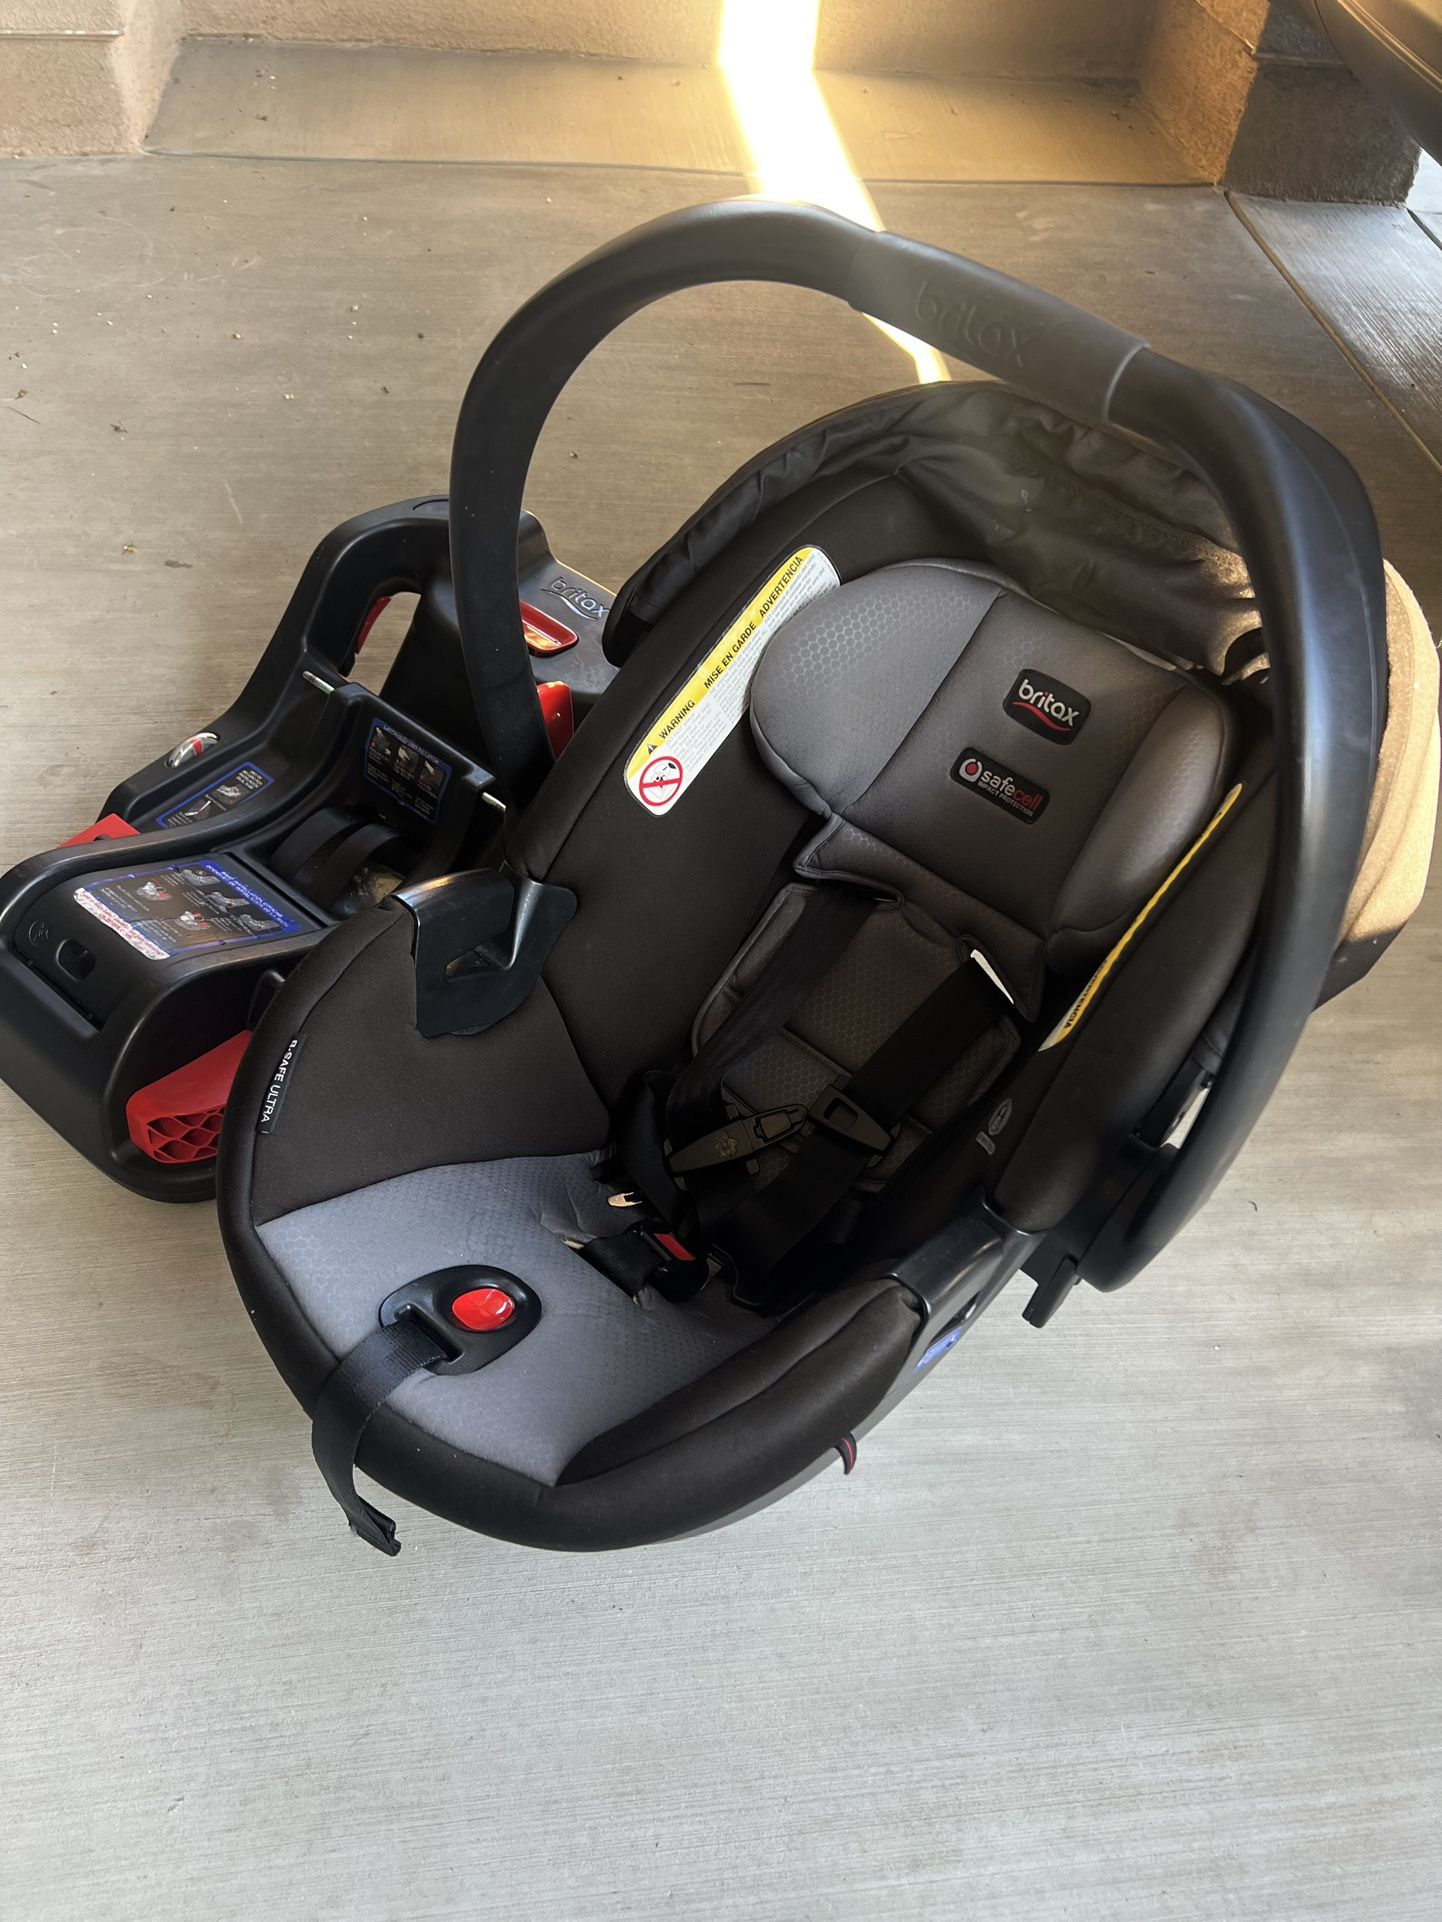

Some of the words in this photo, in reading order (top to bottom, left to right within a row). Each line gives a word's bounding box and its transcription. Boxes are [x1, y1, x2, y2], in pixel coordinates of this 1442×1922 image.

[915, 279, 1031, 368] britax
[551, 576, 610, 618] britax
[658, 699, 696, 740] WARNING
[703, 665, 724, 689] MISE
[722, 651, 735, 668] EN
[731, 621, 758, 654] GARDE
[758, 555, 803, 618] ADVERTENCIA
[1018, 678, 1080, 727] britax
[977, 780, 1001, 797] IMPACT
[999, 792, 1034, 817] PROTECTION
[980, 768, 1044, 811] safecell
[260, 1084, 281, 1123] ULTRA
